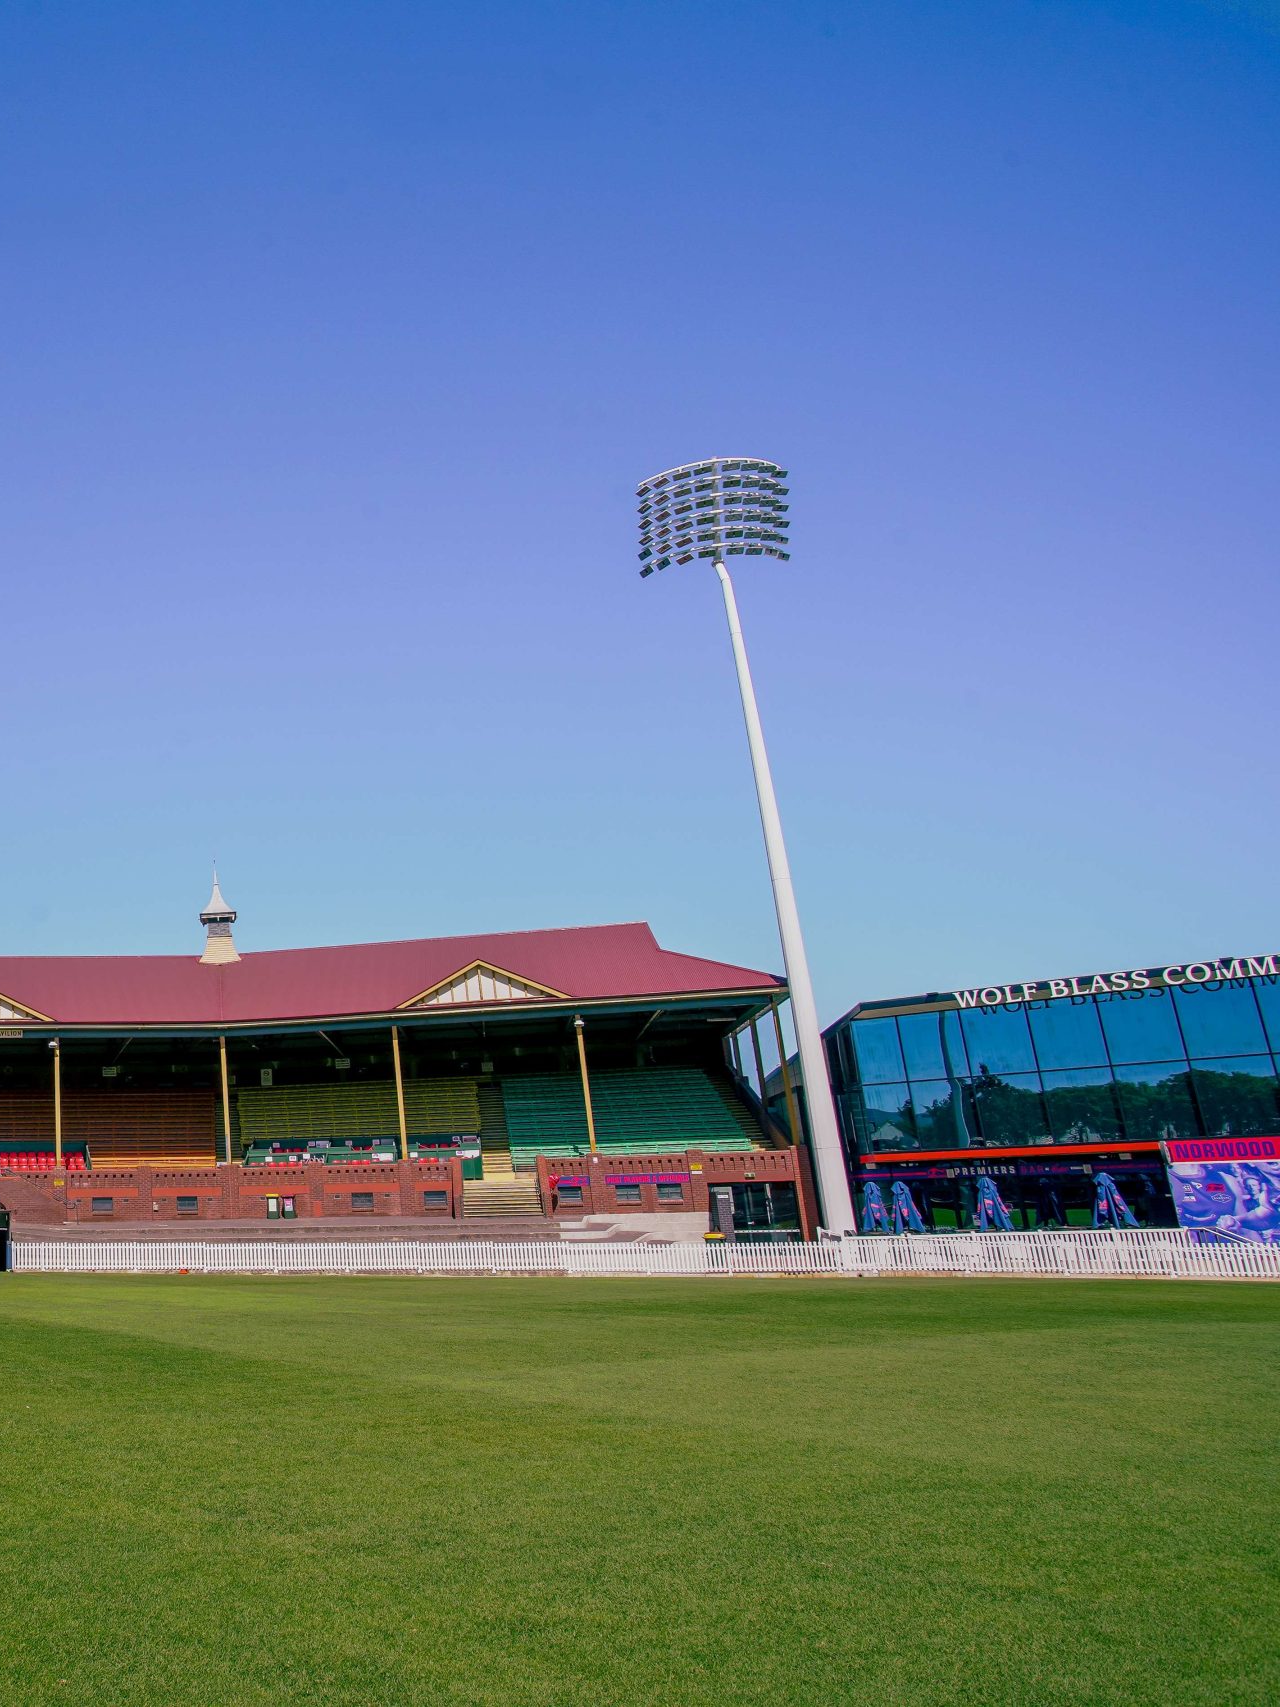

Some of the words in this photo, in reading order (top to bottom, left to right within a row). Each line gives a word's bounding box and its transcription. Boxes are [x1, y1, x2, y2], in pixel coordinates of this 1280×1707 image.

[952, 982, 1037, 1009] WOLF
[1047, 970, 1151, 998] BLASS
[1162, 955, 1280, 986] COMM
[1174, 1140, 1276, 1160] NORWOOD
[954, 1166, 1016, 1177] PREMIERS
